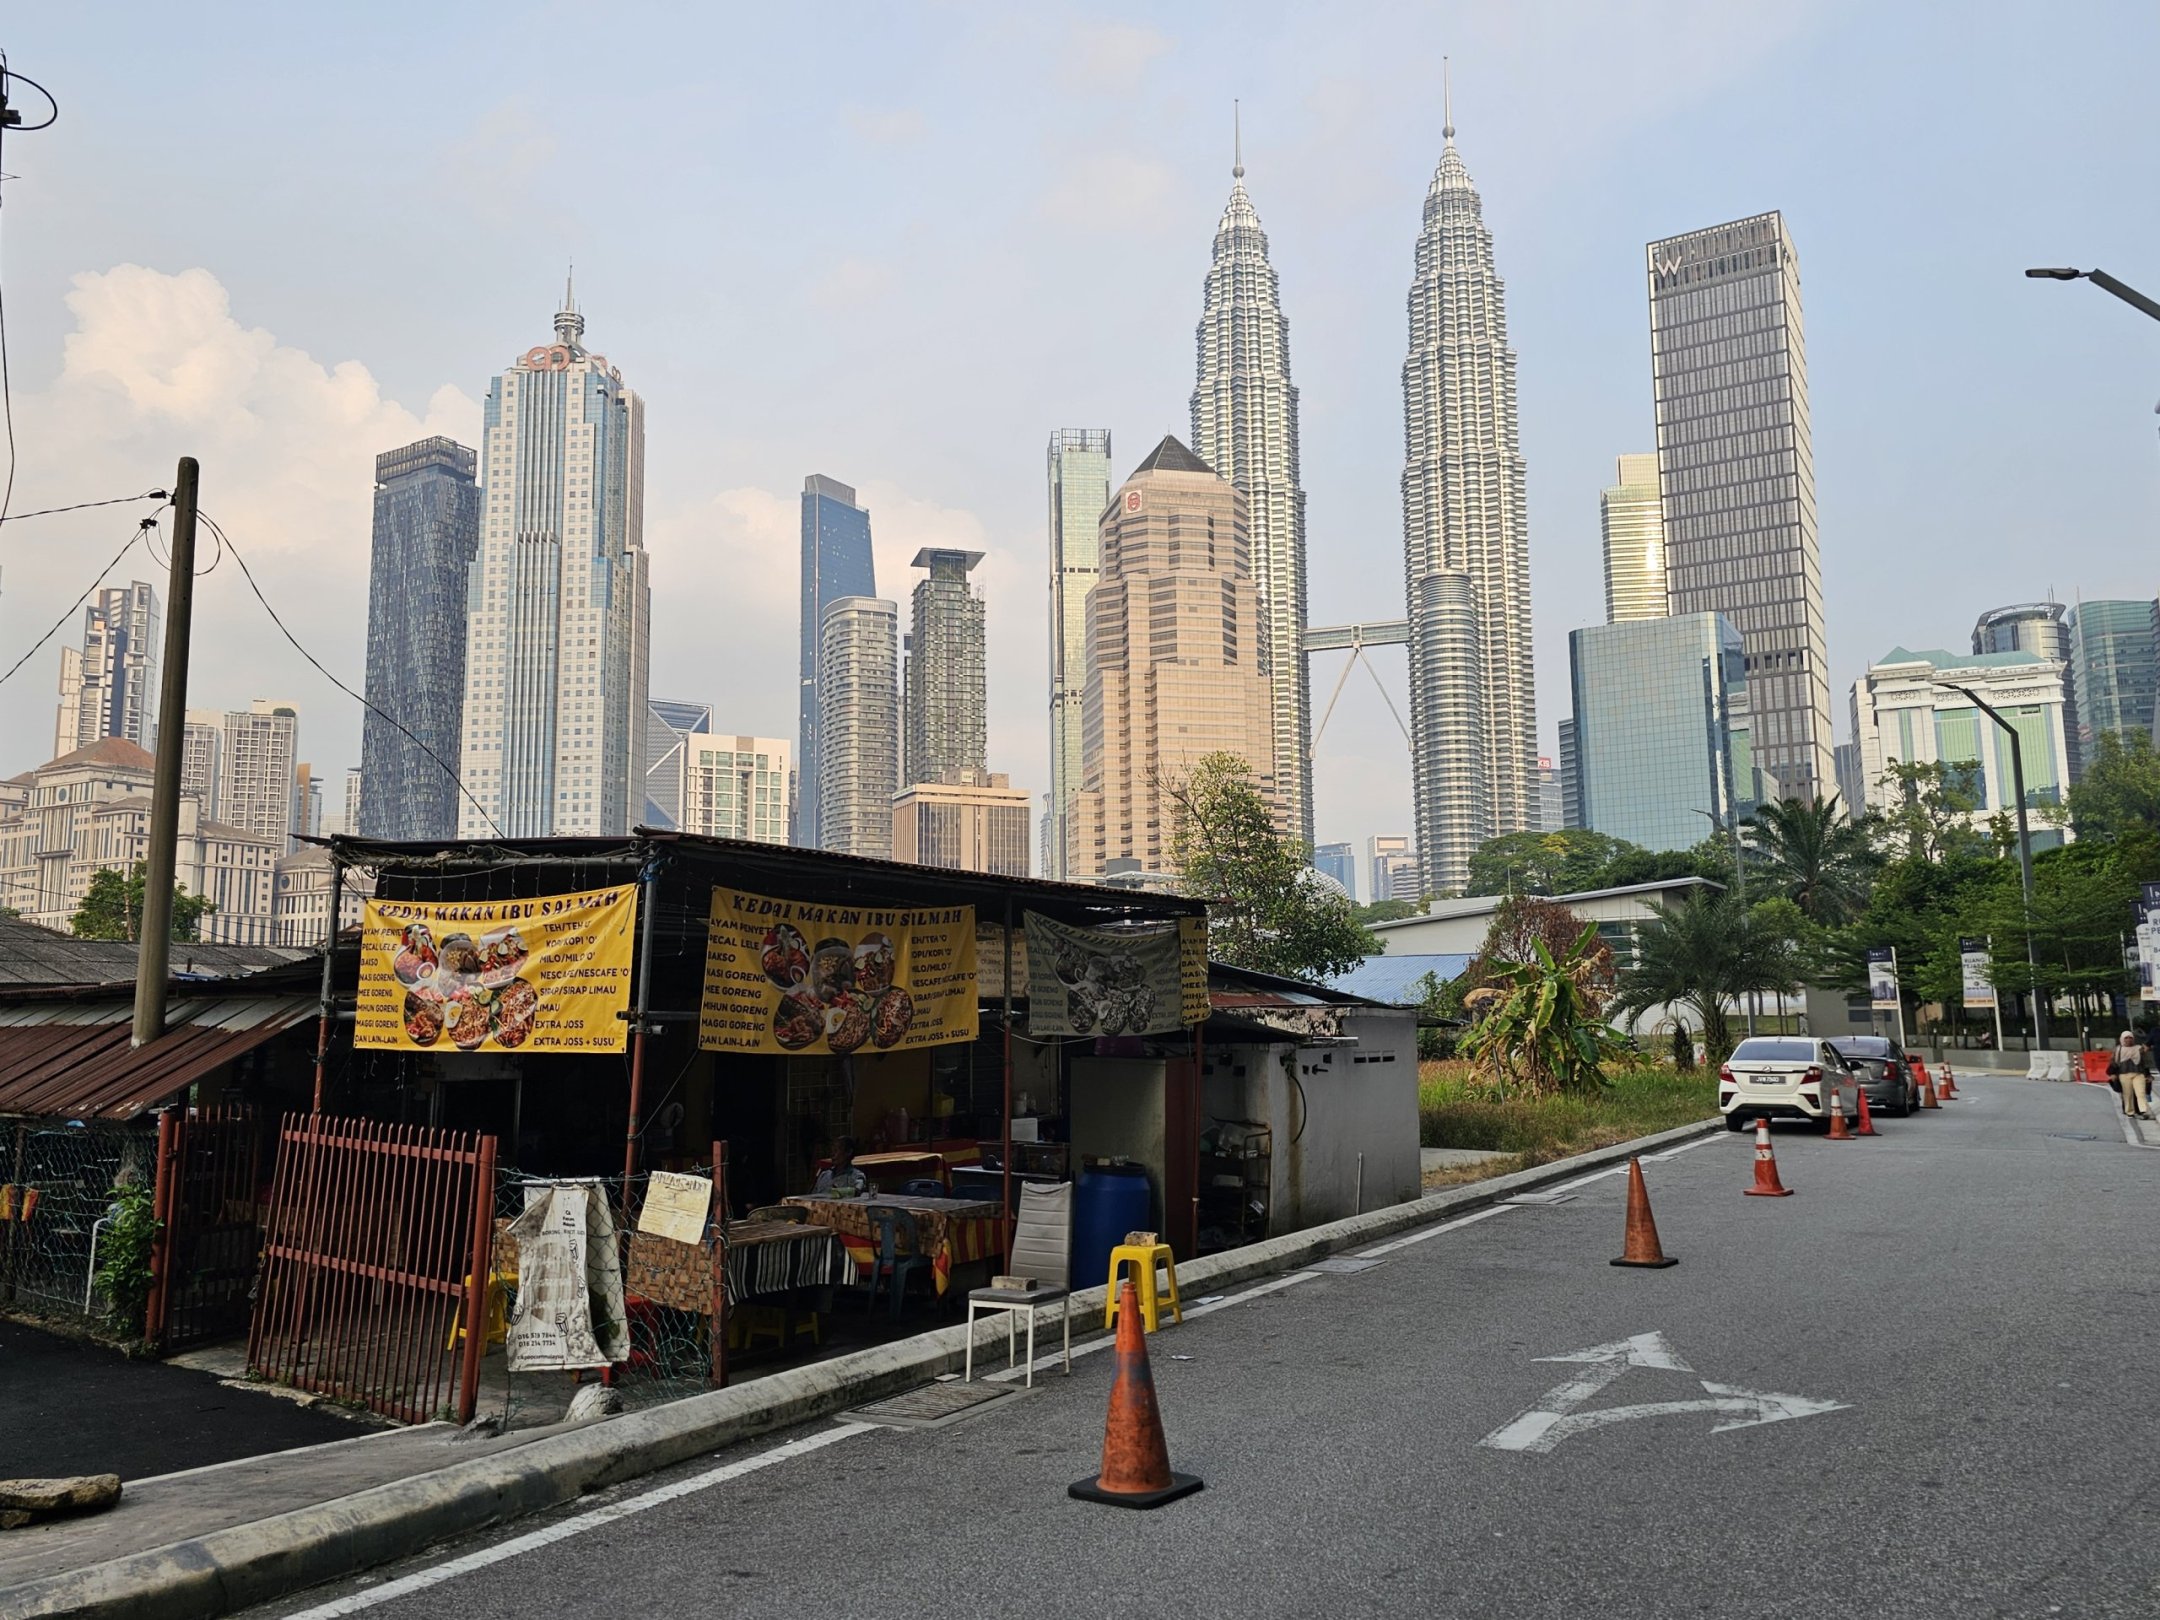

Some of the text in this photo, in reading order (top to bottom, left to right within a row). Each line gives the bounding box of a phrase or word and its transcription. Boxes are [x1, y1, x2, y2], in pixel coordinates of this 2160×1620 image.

[1656, 256, 1682, 277] W
[378, 904, 429, 920] KEDAI
[435, 906, 495, 920] MAKAN
[501, 903, 534, 919] IBU
[733, 895, 962, 926] KEDAI MAKAN IBU SLMAH
[711, 918, 771, 935] AYAM PENYET
[741, 939, 759, 950] LELE
[707, 968, 766, 983] NASI GORENG
[589, 986, 616, 995] LIMAU
[705, 985, 761, 999] MEE GORENG
[535, 1003, 560, 1012] LIMAU
[703, 1001, 768, 1015] MIHUN GORENG
[535, 1020, 584, 1029] EXTRA JOSS
[701, 1018, 765, 1031] MAGGI GORENG
[951, 1028, 969, 1038] SUSU
[355, 1035, 397, 1044] DAN LAIN-LAIN
[534, 1037, 561, 1046] EXTRA
[564, 1037, 583, 1046] JOSS
[593, 1037, 614, 1046] SUSU
[700, 1035, 760, 1047] DAN LAIN-LAIN
